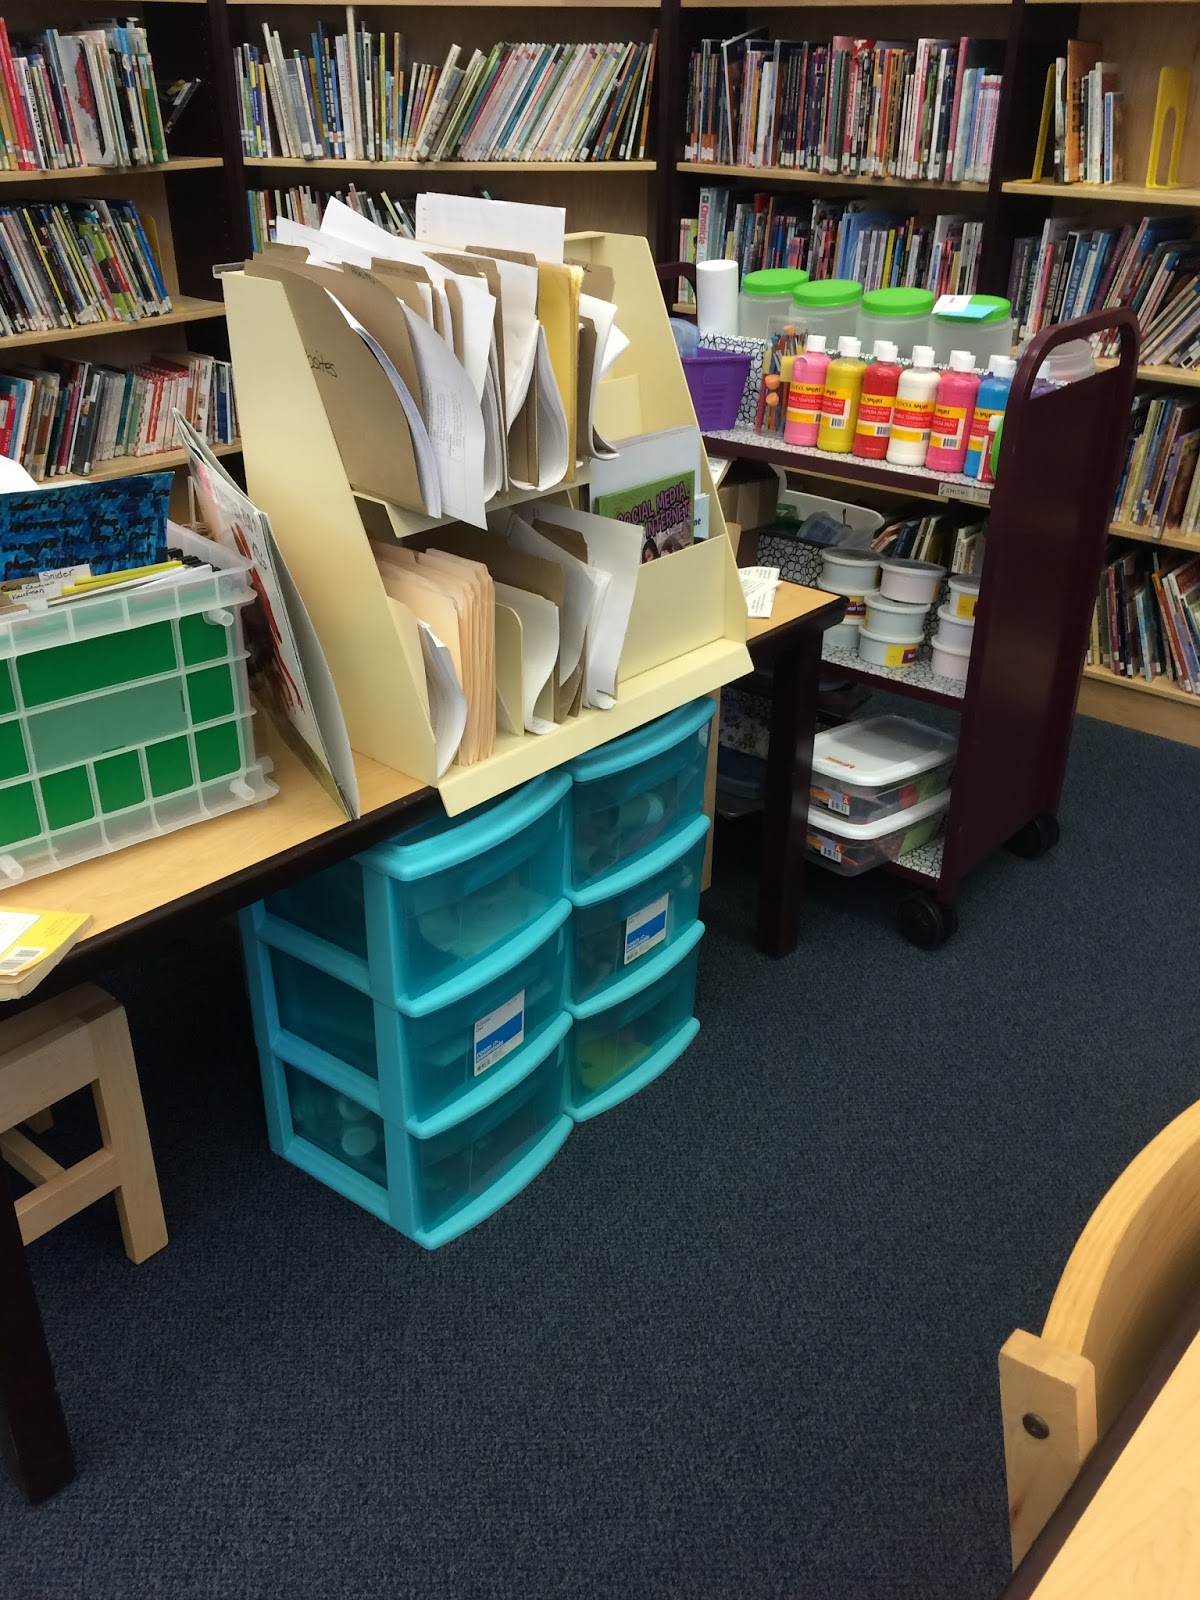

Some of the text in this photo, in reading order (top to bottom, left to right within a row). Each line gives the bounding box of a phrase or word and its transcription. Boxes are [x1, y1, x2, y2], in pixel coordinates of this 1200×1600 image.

[699, 204, 709, 245] Chronicle
[1067, 265, 1080, 308] GREAT LIVES
[656, 481, 686, 511] MEDIA
[645, 499, 690, 539] INTERNET
[43, 569, 74, 580] Snider
[12, 588, 45, 600] Kaufman
